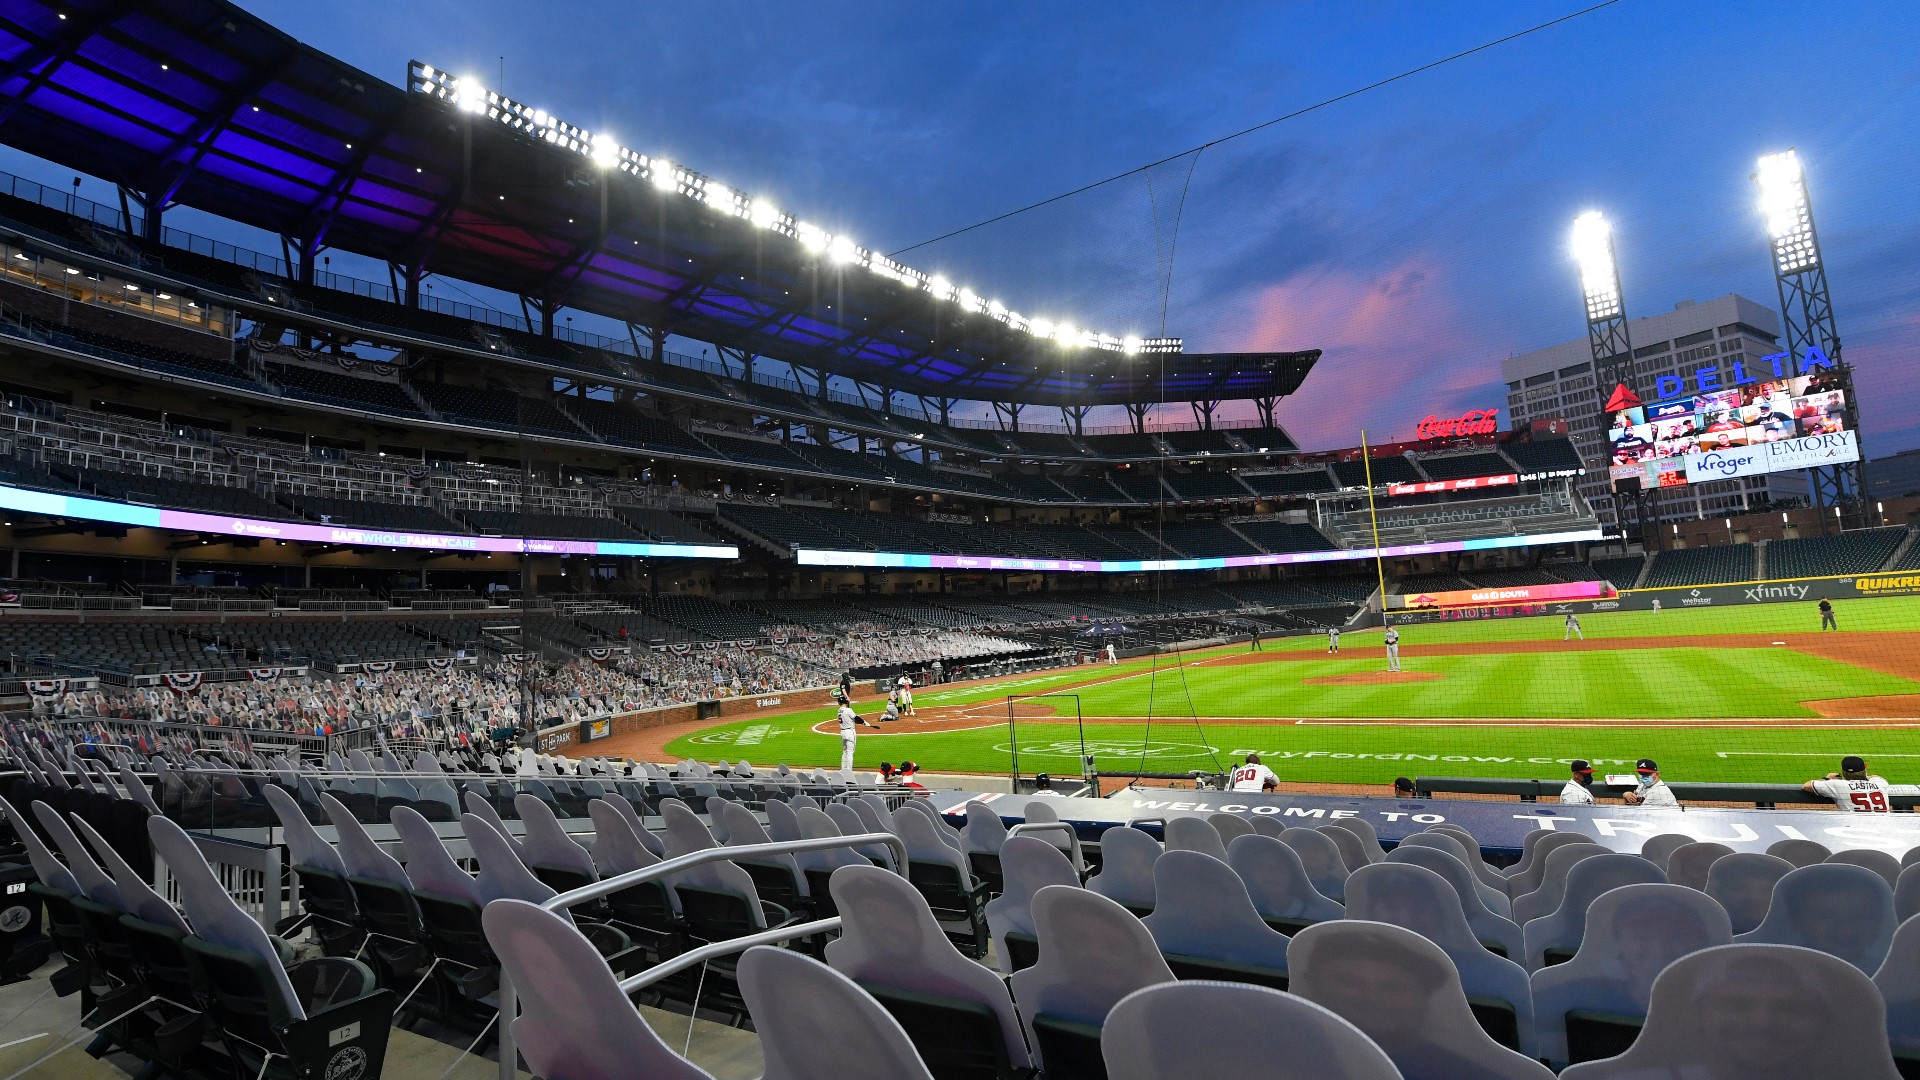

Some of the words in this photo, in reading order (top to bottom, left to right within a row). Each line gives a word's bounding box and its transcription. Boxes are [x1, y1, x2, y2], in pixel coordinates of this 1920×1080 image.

[1656, 345, 1833, 400] DELTA
[1417, 408, 1499, 440] Coca-Cola
[1770, 431, 1850, 456] EMORY
[1697, 453, 1753, 475] Kroger
[1499, 590, 1529, 599] SOUTH
[1744, 583, 1810, 602] xfinity
[762, 698, 782, 707] Mobile
[556, 731, 571, 745] PARK
[1235, 768, 1257, 783] 20
[1848, 780, 1880, 791] CASTRO
[1849, 791, 1888, 812] 59
[1131, 800, 1361, 819] WELCOME
[1379, 811, 1446, 824] TO
[1512, 814, 1920, 850] TRUIS
[11, 884, 22, 893] 12
[340, 1027, 351, 1040] 12
